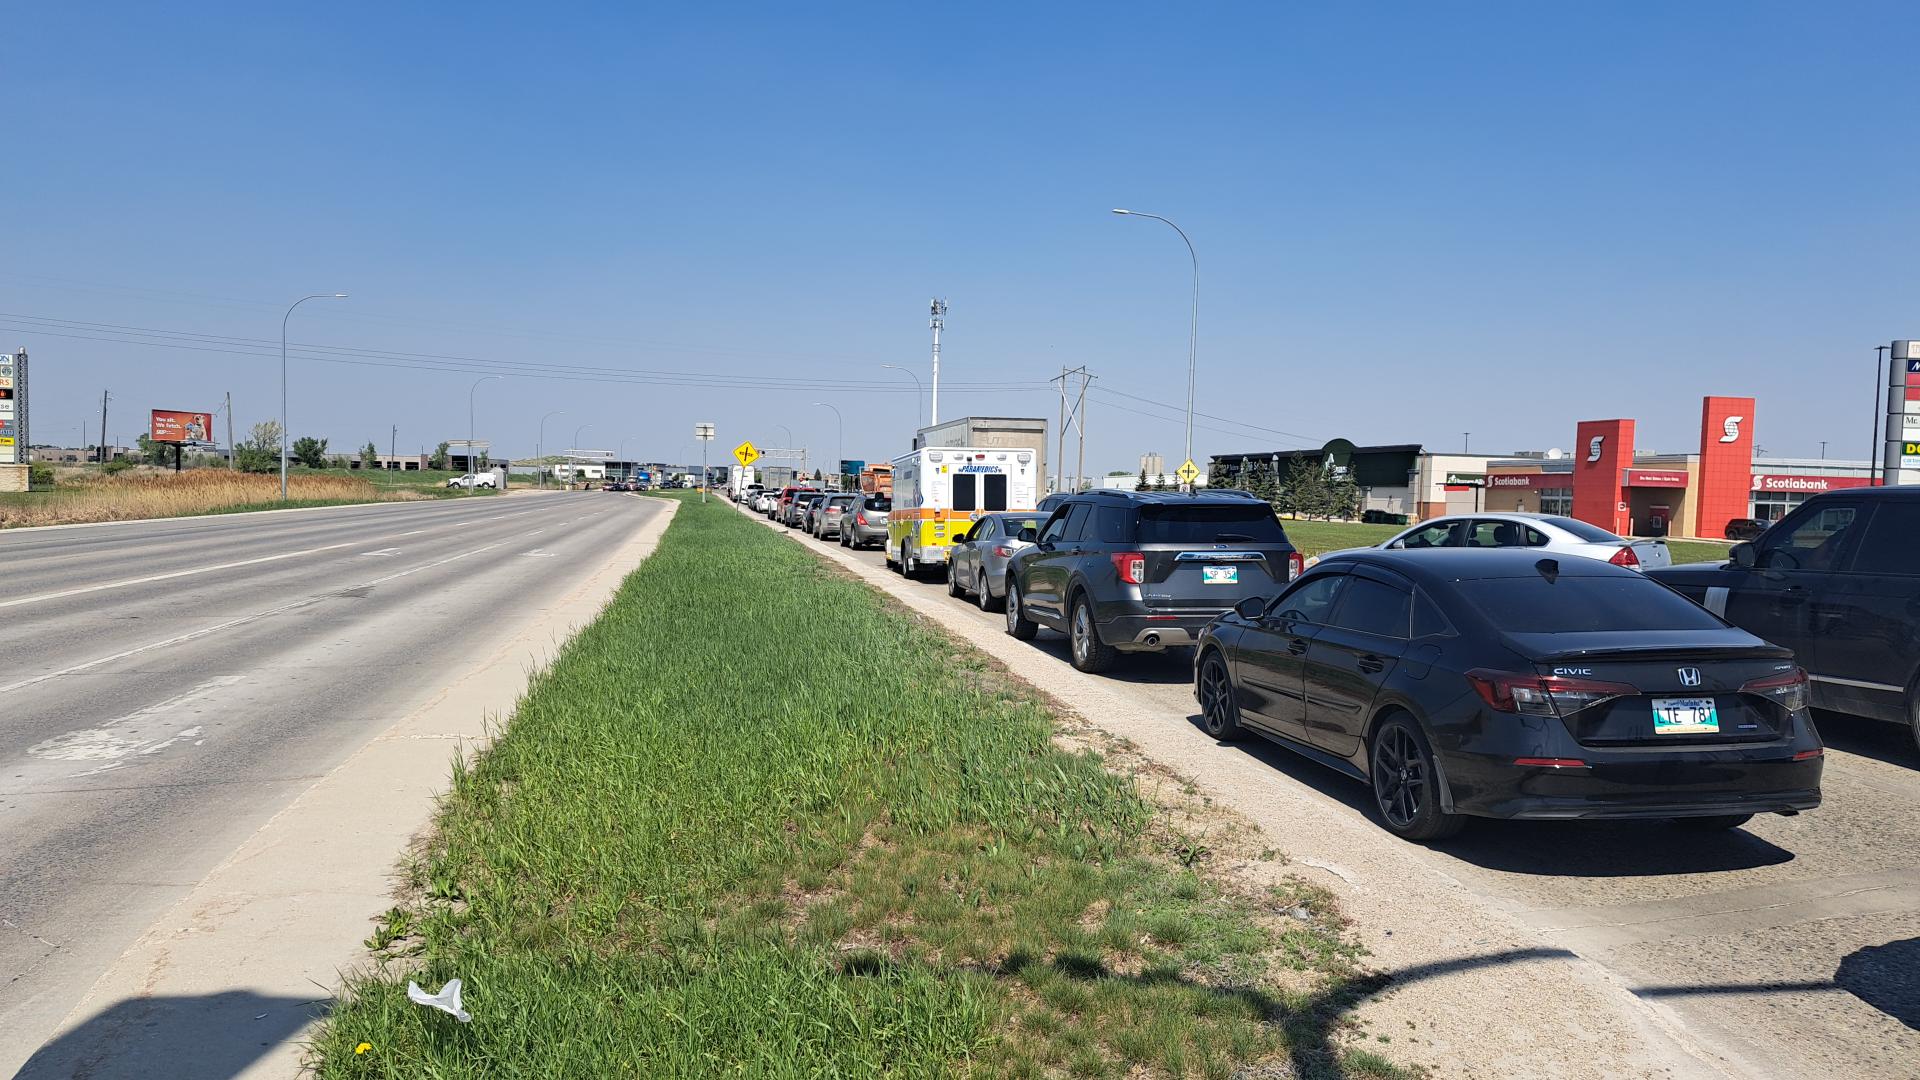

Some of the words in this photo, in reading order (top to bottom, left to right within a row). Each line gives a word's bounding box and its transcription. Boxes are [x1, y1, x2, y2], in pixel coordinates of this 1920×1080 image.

[962, 465, 999, 473] PARAMEDICS
[1494, 476, 1530, 486] Scotiabank
[1766, 478, 1828, 490] Scotiabank
[1553, 667, 1592, 675] CIVIC
[1656, 706, 1682, 724] LTE
[1689, 706, 1713, 723] 781
